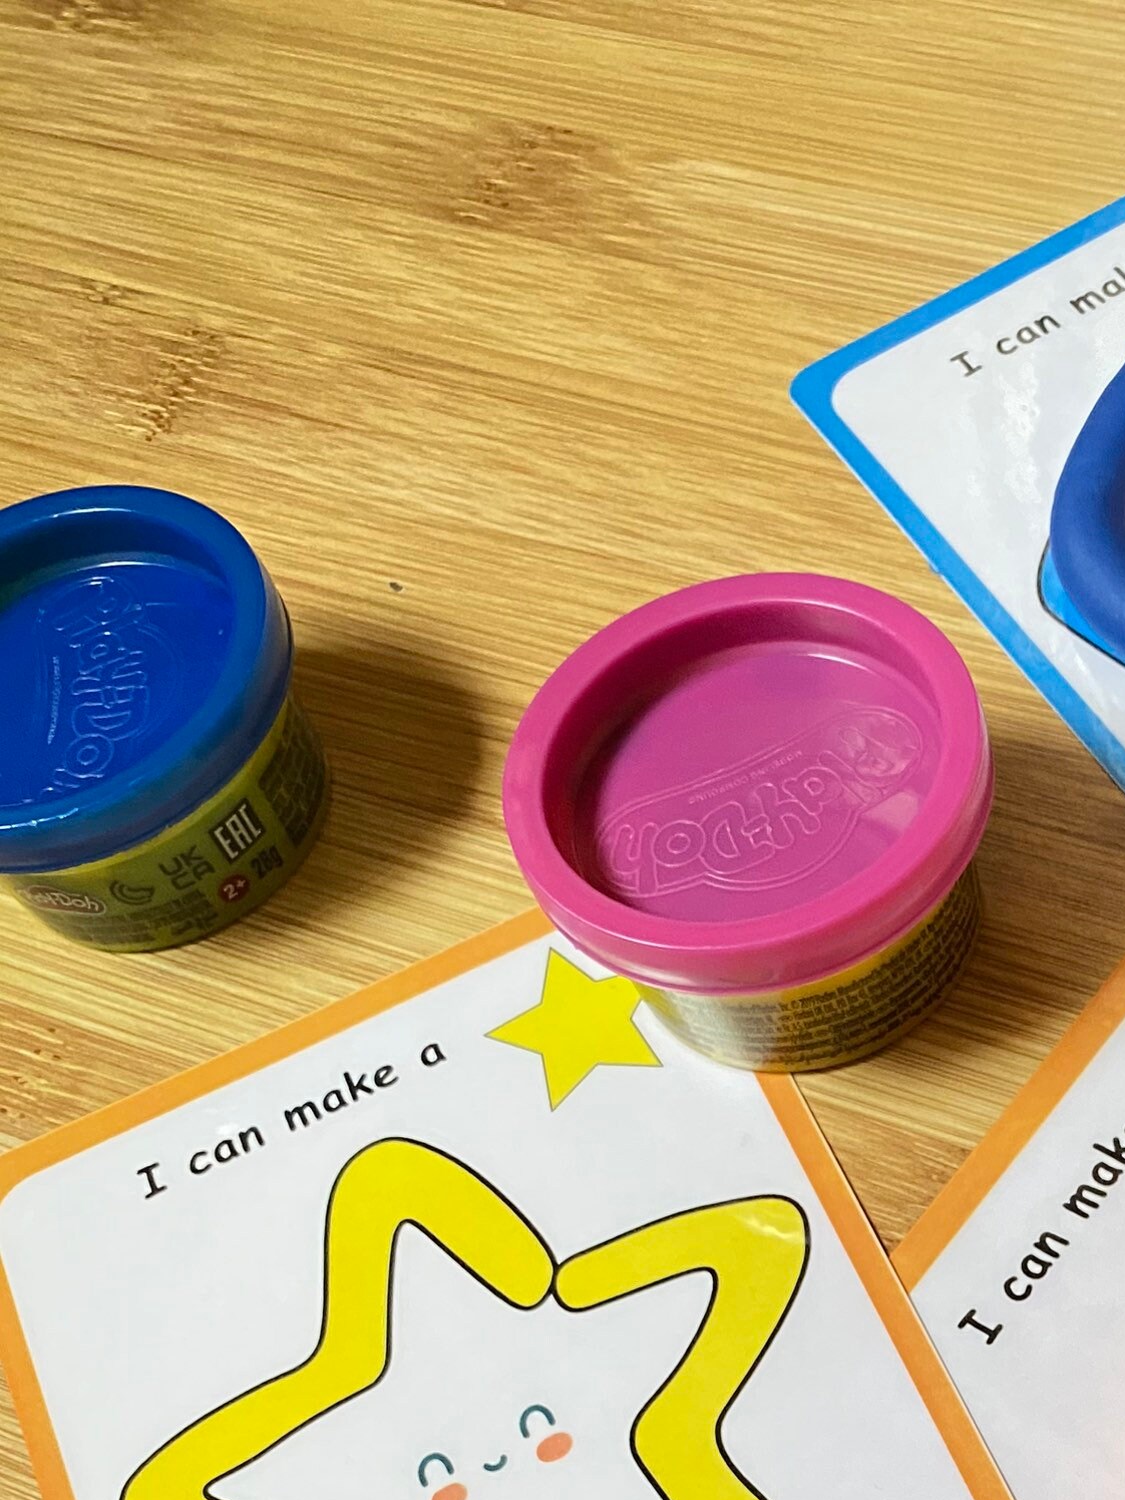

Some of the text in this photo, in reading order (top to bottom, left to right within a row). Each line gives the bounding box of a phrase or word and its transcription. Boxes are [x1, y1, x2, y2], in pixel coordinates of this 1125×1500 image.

[950, 351, 983, 377] I
[995, 313, 1062, 356] can
[611, 725, 916, 895] Play-Doh
[136, 1043, 448, 1200] I can make a
[957, 1308, 1004, 1346] I
[1003, 1231, 1070, 1302] can
